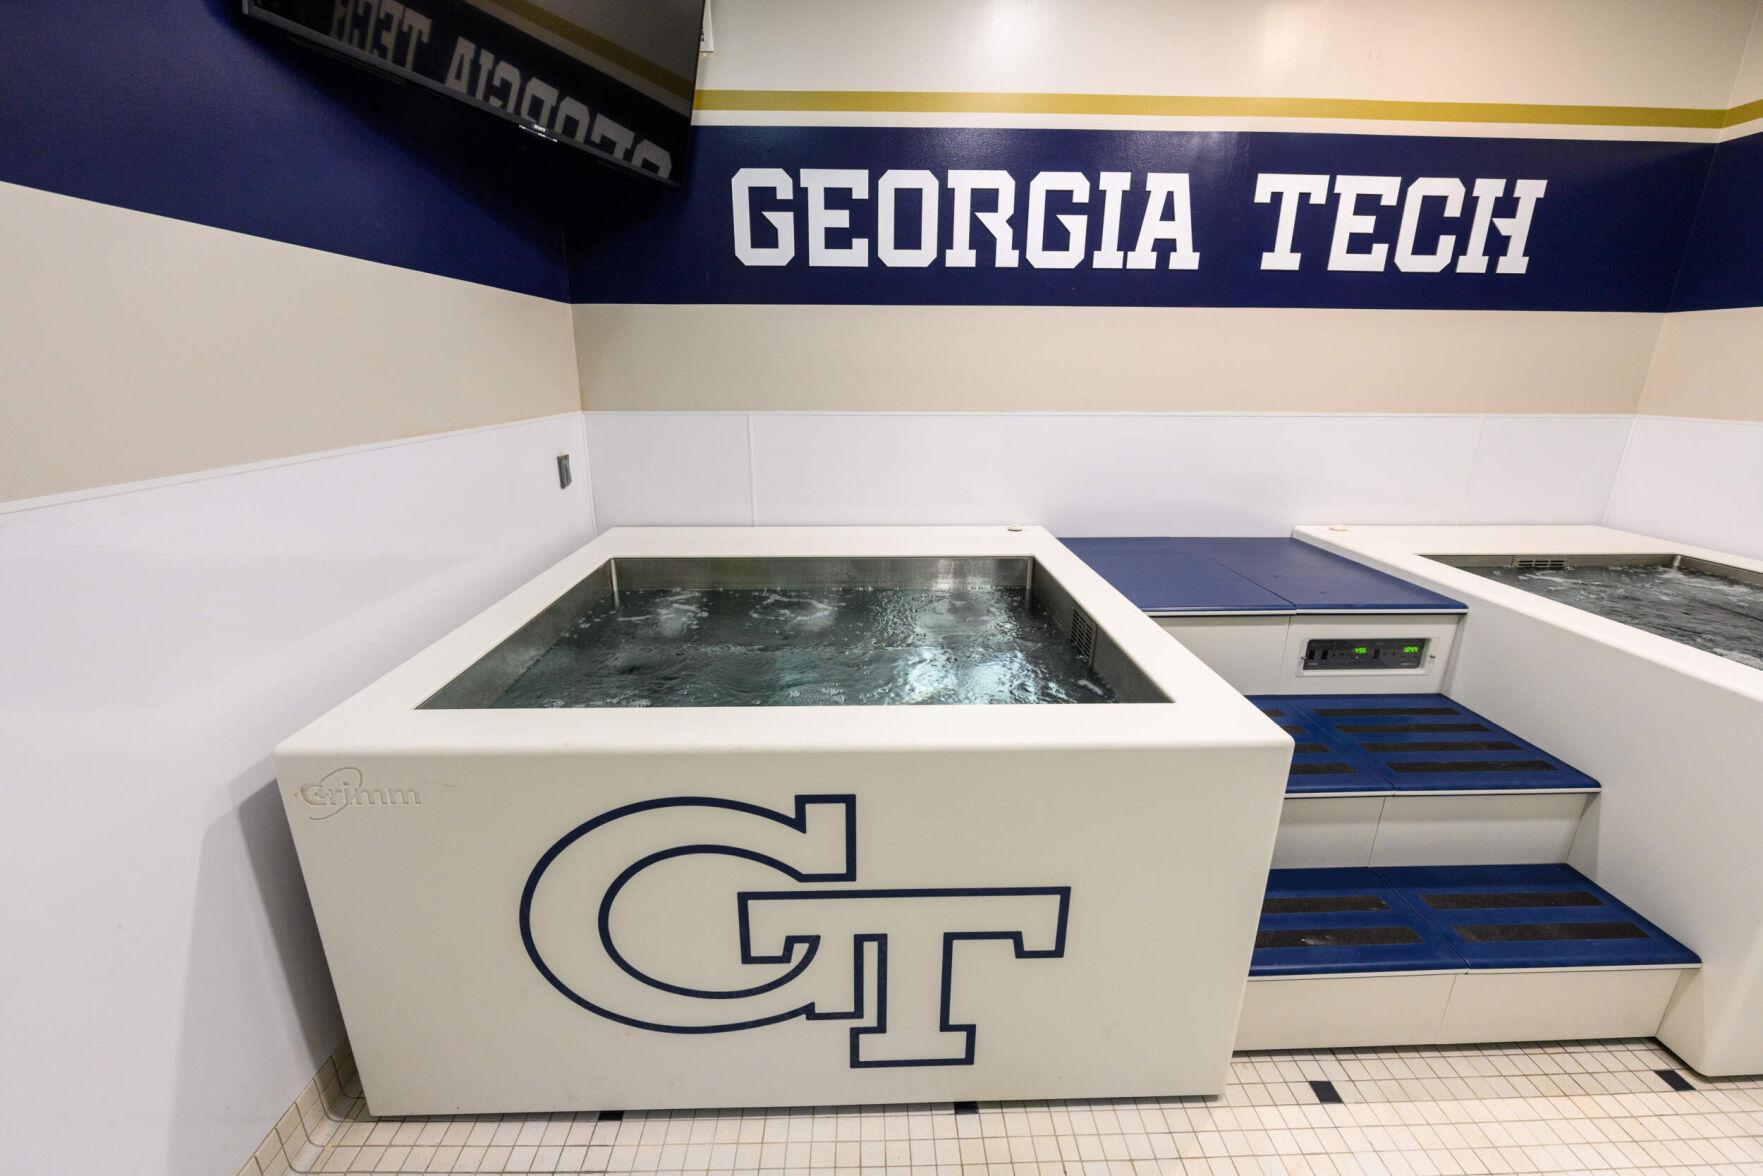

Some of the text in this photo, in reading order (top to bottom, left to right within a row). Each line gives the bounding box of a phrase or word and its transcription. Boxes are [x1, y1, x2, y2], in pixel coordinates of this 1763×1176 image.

[731, 167, 1549, 275] GEORGIA TECH
[298, 778, 422, 809] Grimm
[519, 793, 1072, 1069] GT
